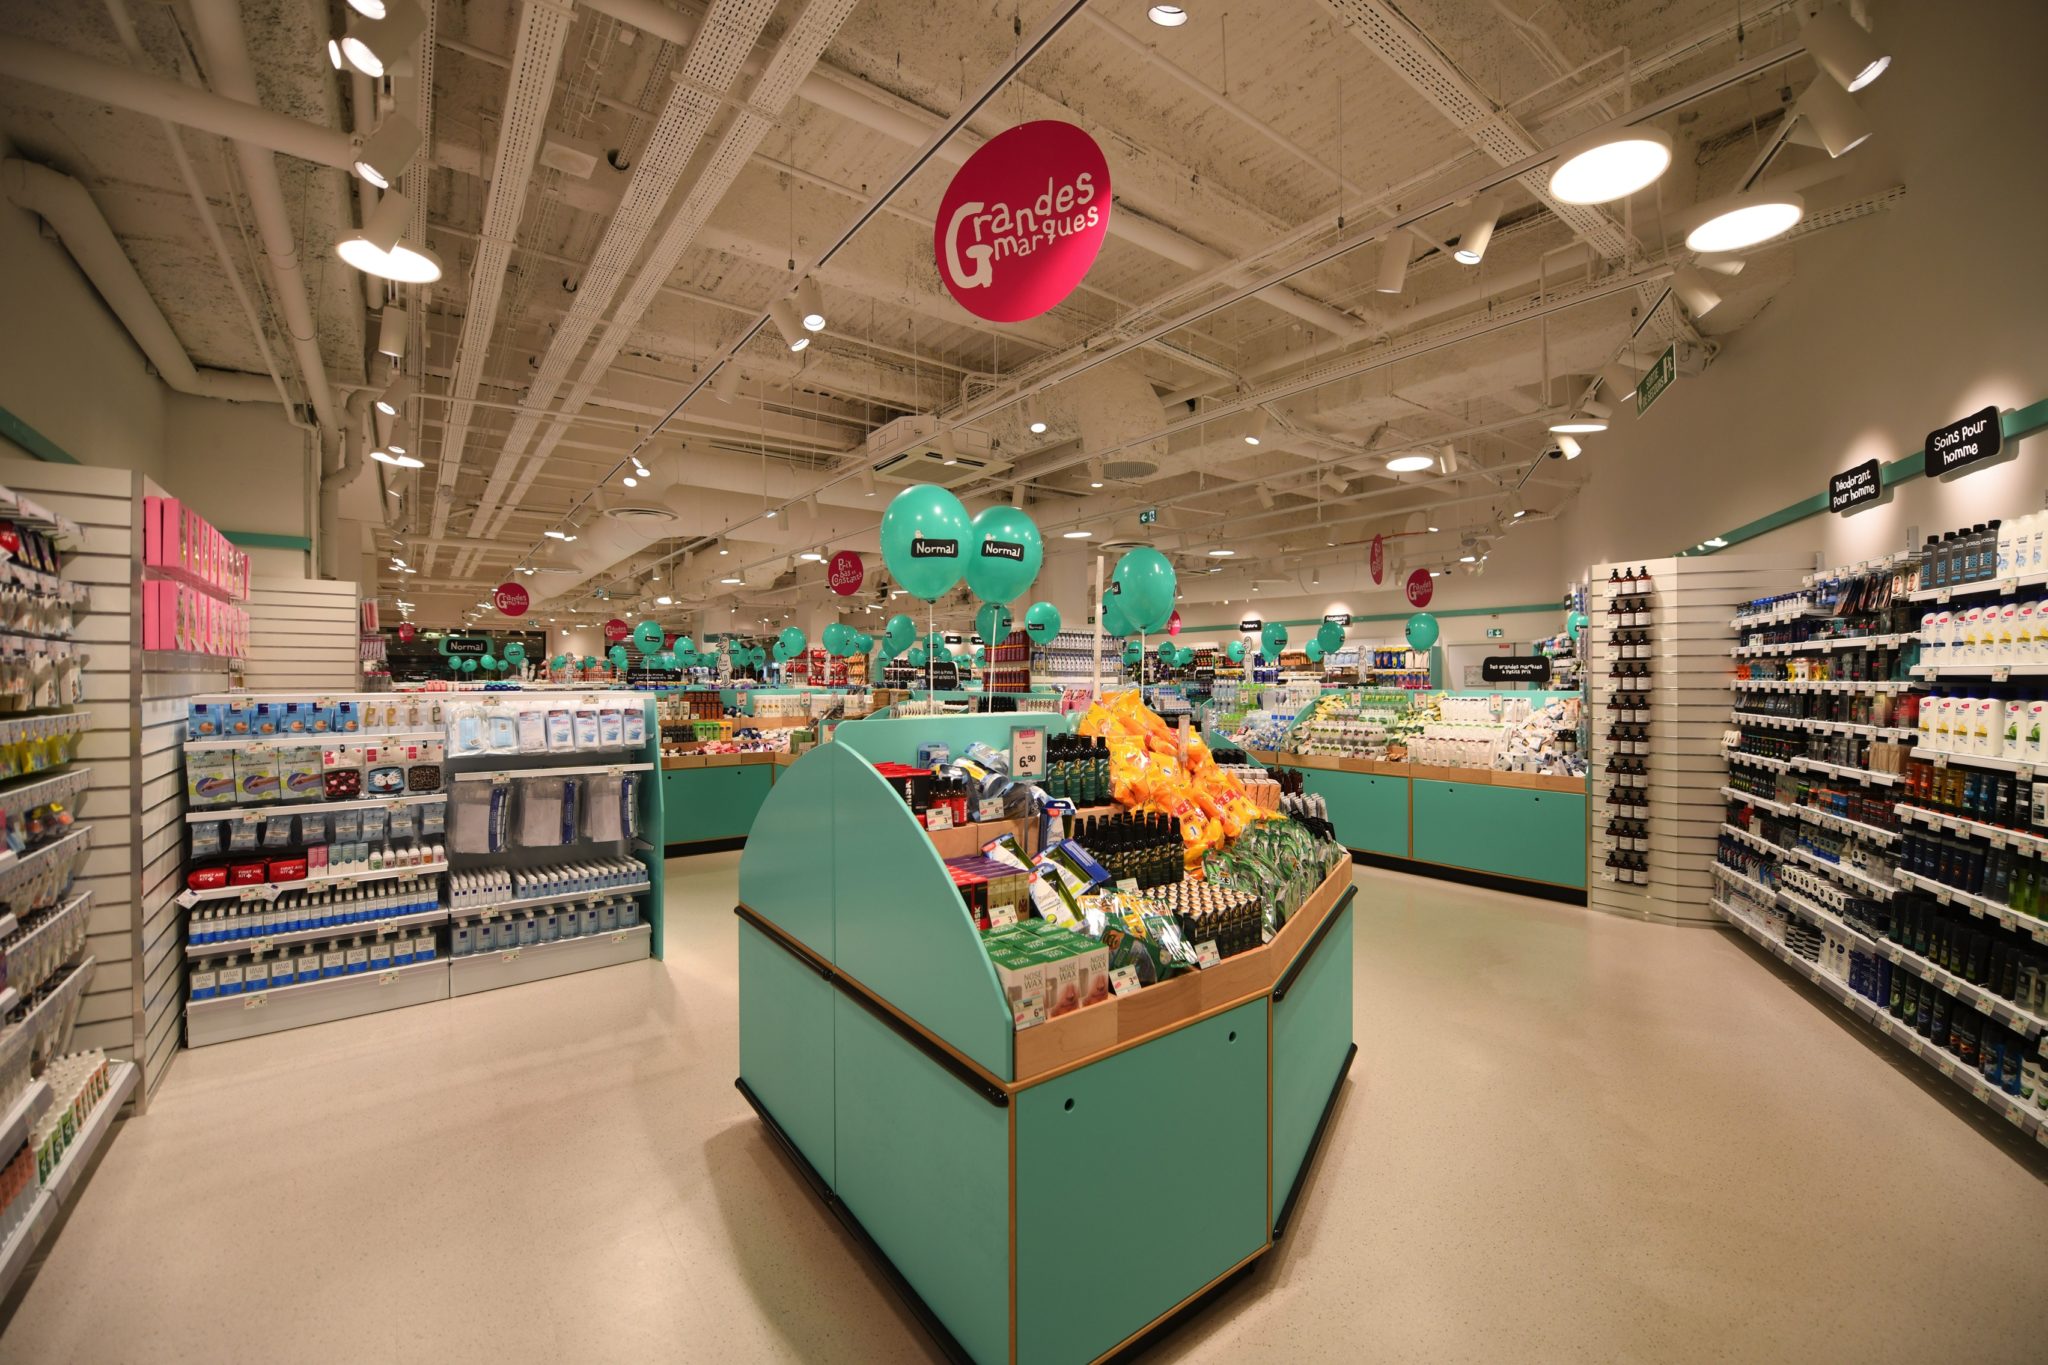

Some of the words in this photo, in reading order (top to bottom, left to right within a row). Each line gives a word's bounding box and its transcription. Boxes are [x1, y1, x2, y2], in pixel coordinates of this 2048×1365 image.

[945, 172, 1095, 288] Grandes
[994, 206, 1099, 261] marques
[1934, 430, 1960, 451] Soins
[1943, 442, 1978, 465] homme
[1835, 469, 1871, 493] Déodorant
[1850, 484, 1876, 501] homme
[916, 541, 955, 554] Normal
[985, 543, 1021, 557] Normal
[838, 558, 852, 571] Prix
[496, 592, 527, 609] Grandes
[450, 641, 484, 651] Normal
[1019, 754, 1036, 768] 6.90
[1090, 954, 1106, 965] NOSE
[1059, 962, 1076, 973] NOSE
[1090, 961, 1106, 972] WAX
[1024, 971, 1042, 981] NOSE
[1059, 970, 1077, 982] WAX
[1024, 979, 1043, 990] WAX
